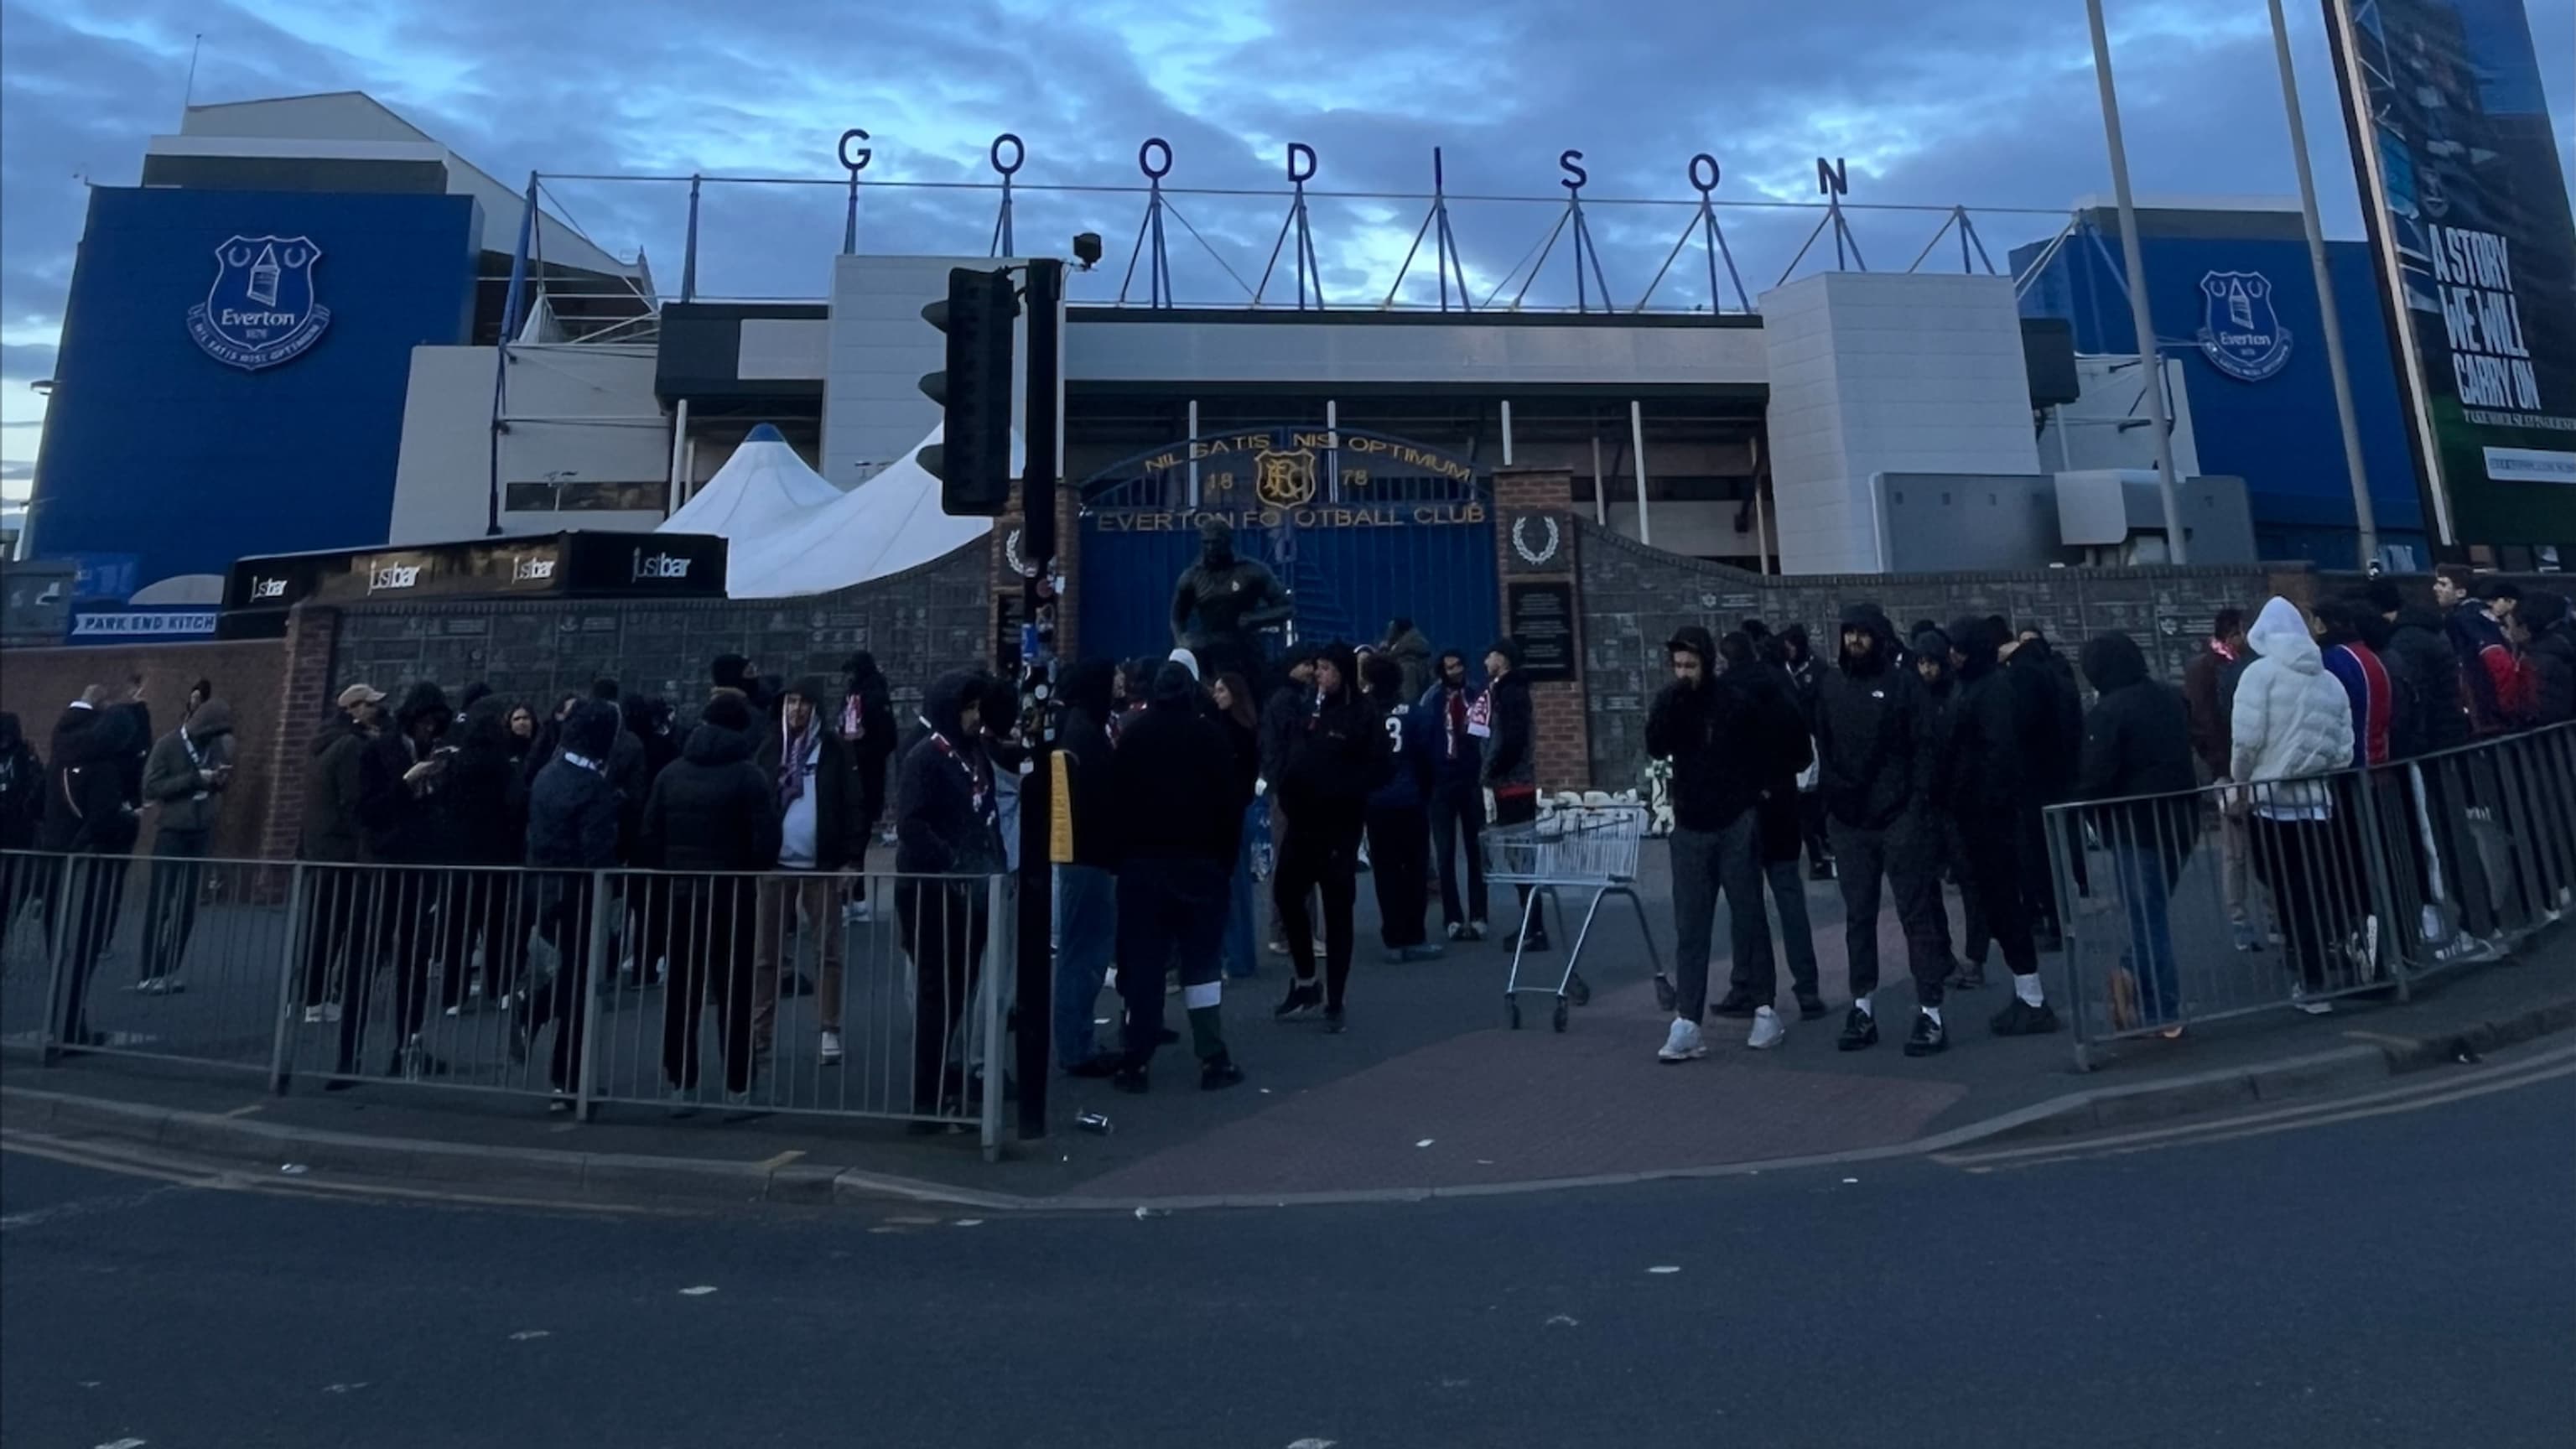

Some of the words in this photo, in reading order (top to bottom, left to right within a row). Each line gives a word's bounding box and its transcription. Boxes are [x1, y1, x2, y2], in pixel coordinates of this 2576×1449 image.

[839, 129, 1847, 195] GOODISON
[2428, 223, 2452, 283] A
[2445, 226, 2513, 293] STORY
[221, 309, 294, 325] Everton
[2437, 284, 2481, 351] WE
[2474, 289, 2530, 358] WILL
[2220, 331, 2272, 345] Everton
[2453, 352, 2515, 408] CARRY
[2511, 359, 2542, 411] ON
[1145, 453, 1183, 473] NIL
[1196, 434, 1270, 459] SATIS
[1294, 433, 1337, 448] NIS
[1348, 437, 1471, 482] OPTIMUM
[1343, 469, 1368, 486] 78
[1097, 510, 1234, 532] EVERTON
[1413, 505, 1486, 524] CLUB
[85, 616, 126, 630] PARK
[132, 616, 164, 630] END
[1384, 716, 1403, 753] 3
